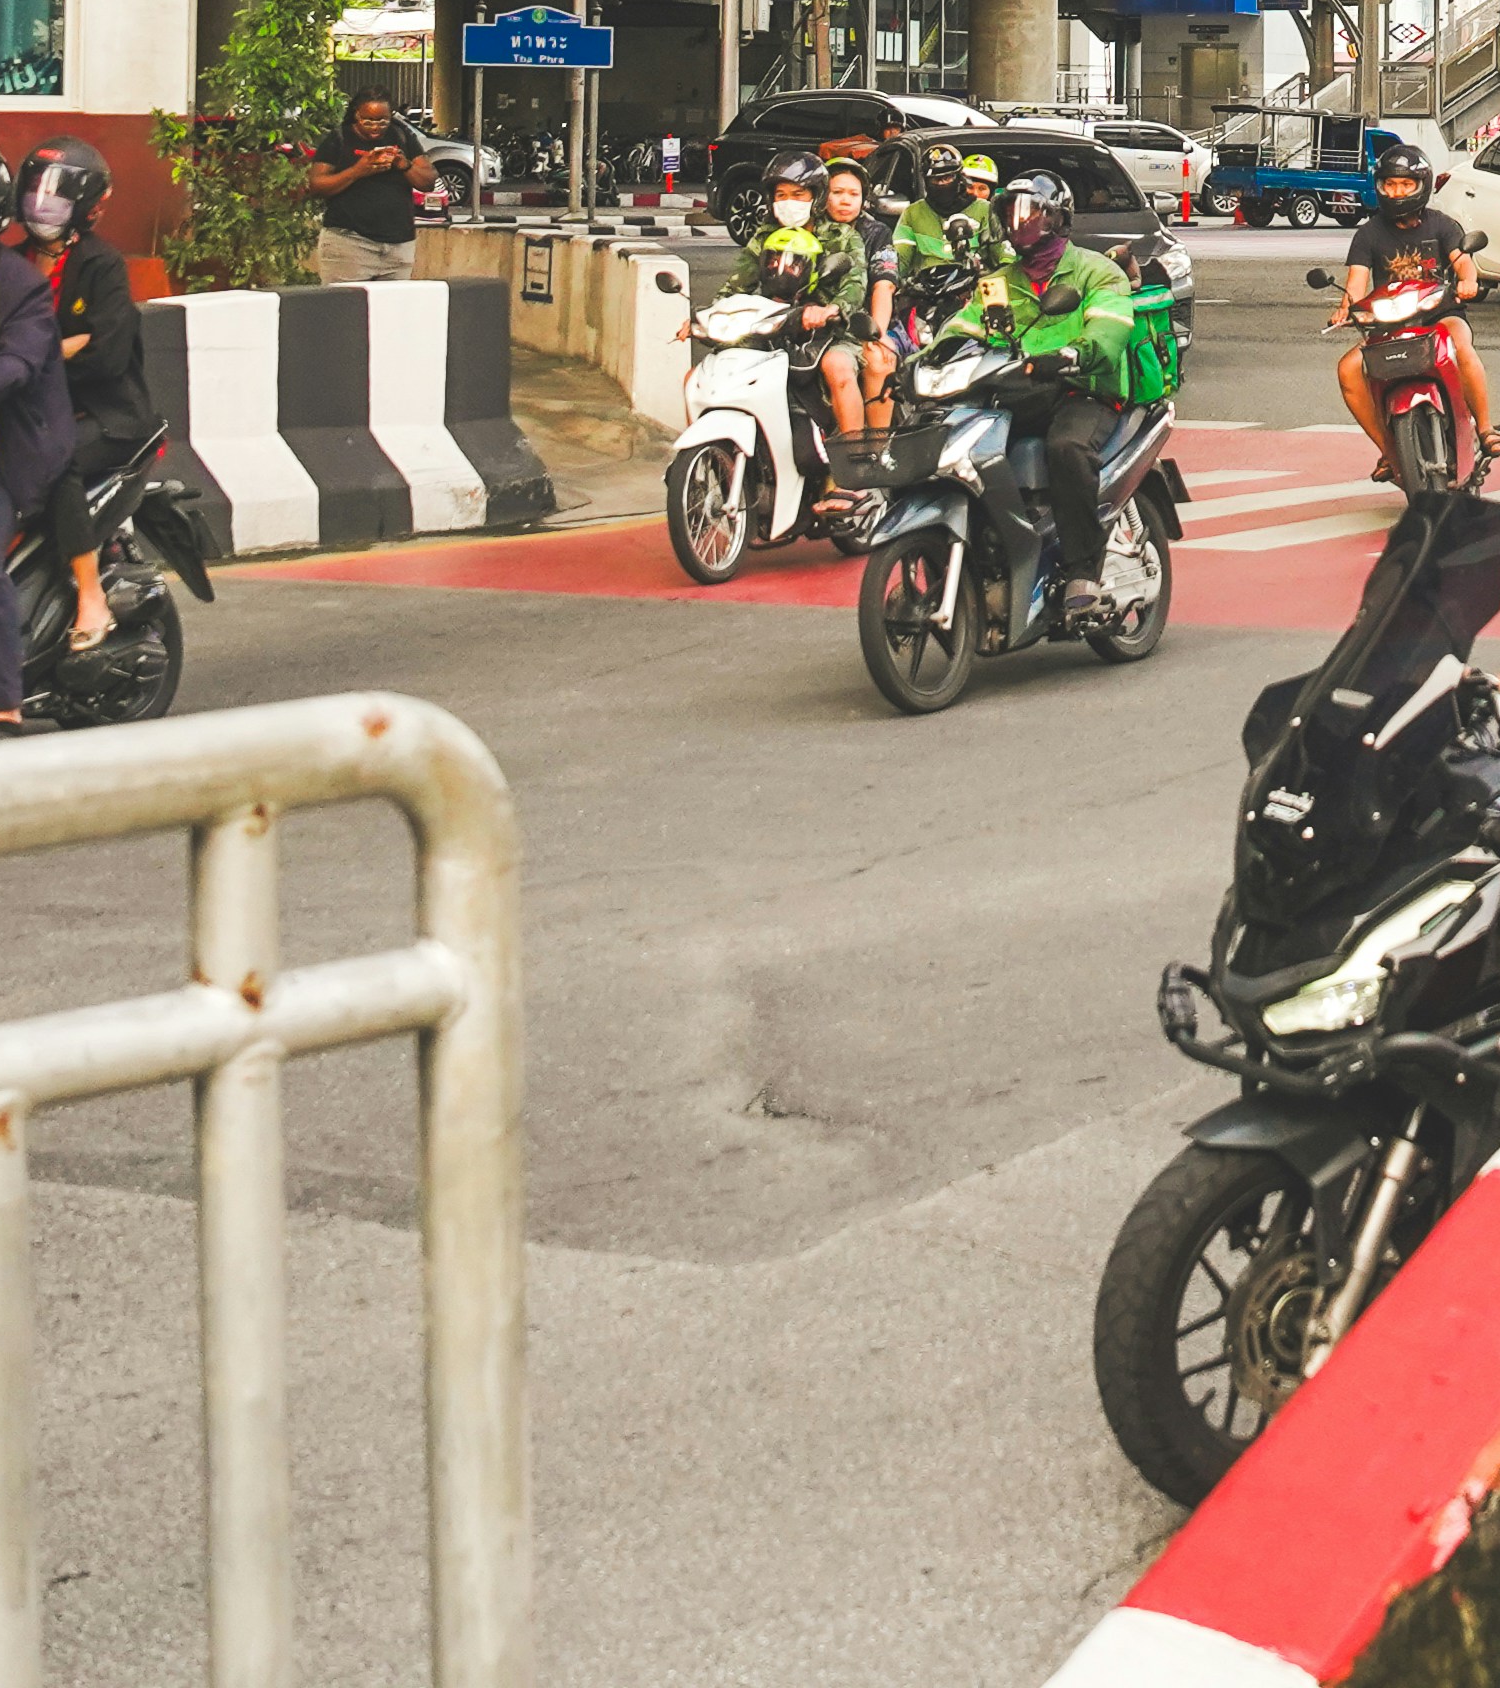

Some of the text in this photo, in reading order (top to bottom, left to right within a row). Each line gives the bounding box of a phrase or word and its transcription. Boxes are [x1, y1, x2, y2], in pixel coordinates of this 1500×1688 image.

[510, 31, 567, 49] ท่าพระ
[513, 54, 564, 64] Tha Phra
